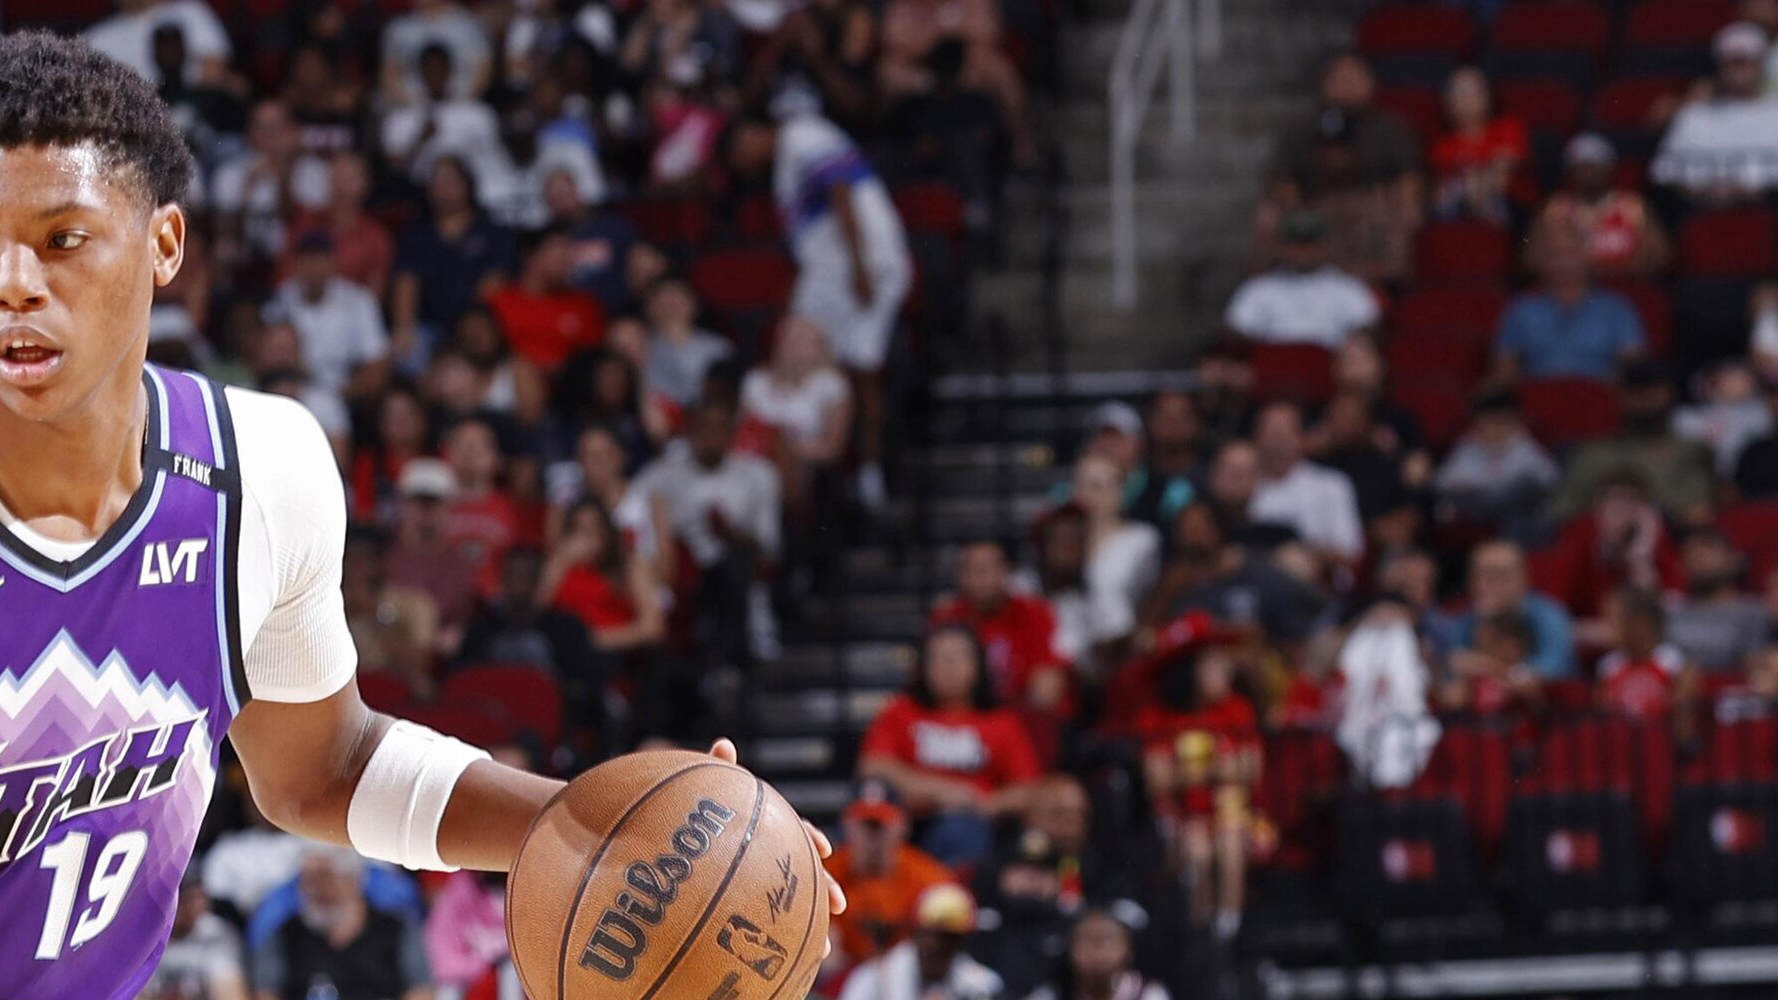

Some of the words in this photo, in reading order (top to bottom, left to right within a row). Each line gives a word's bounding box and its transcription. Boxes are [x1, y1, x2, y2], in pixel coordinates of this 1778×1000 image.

[173, 453, 212, 486] FRANK
[138, 538, 209, 587] LVT
[34, 830, 148, 960] 19
[577, 797, 737, 982] Wilson
